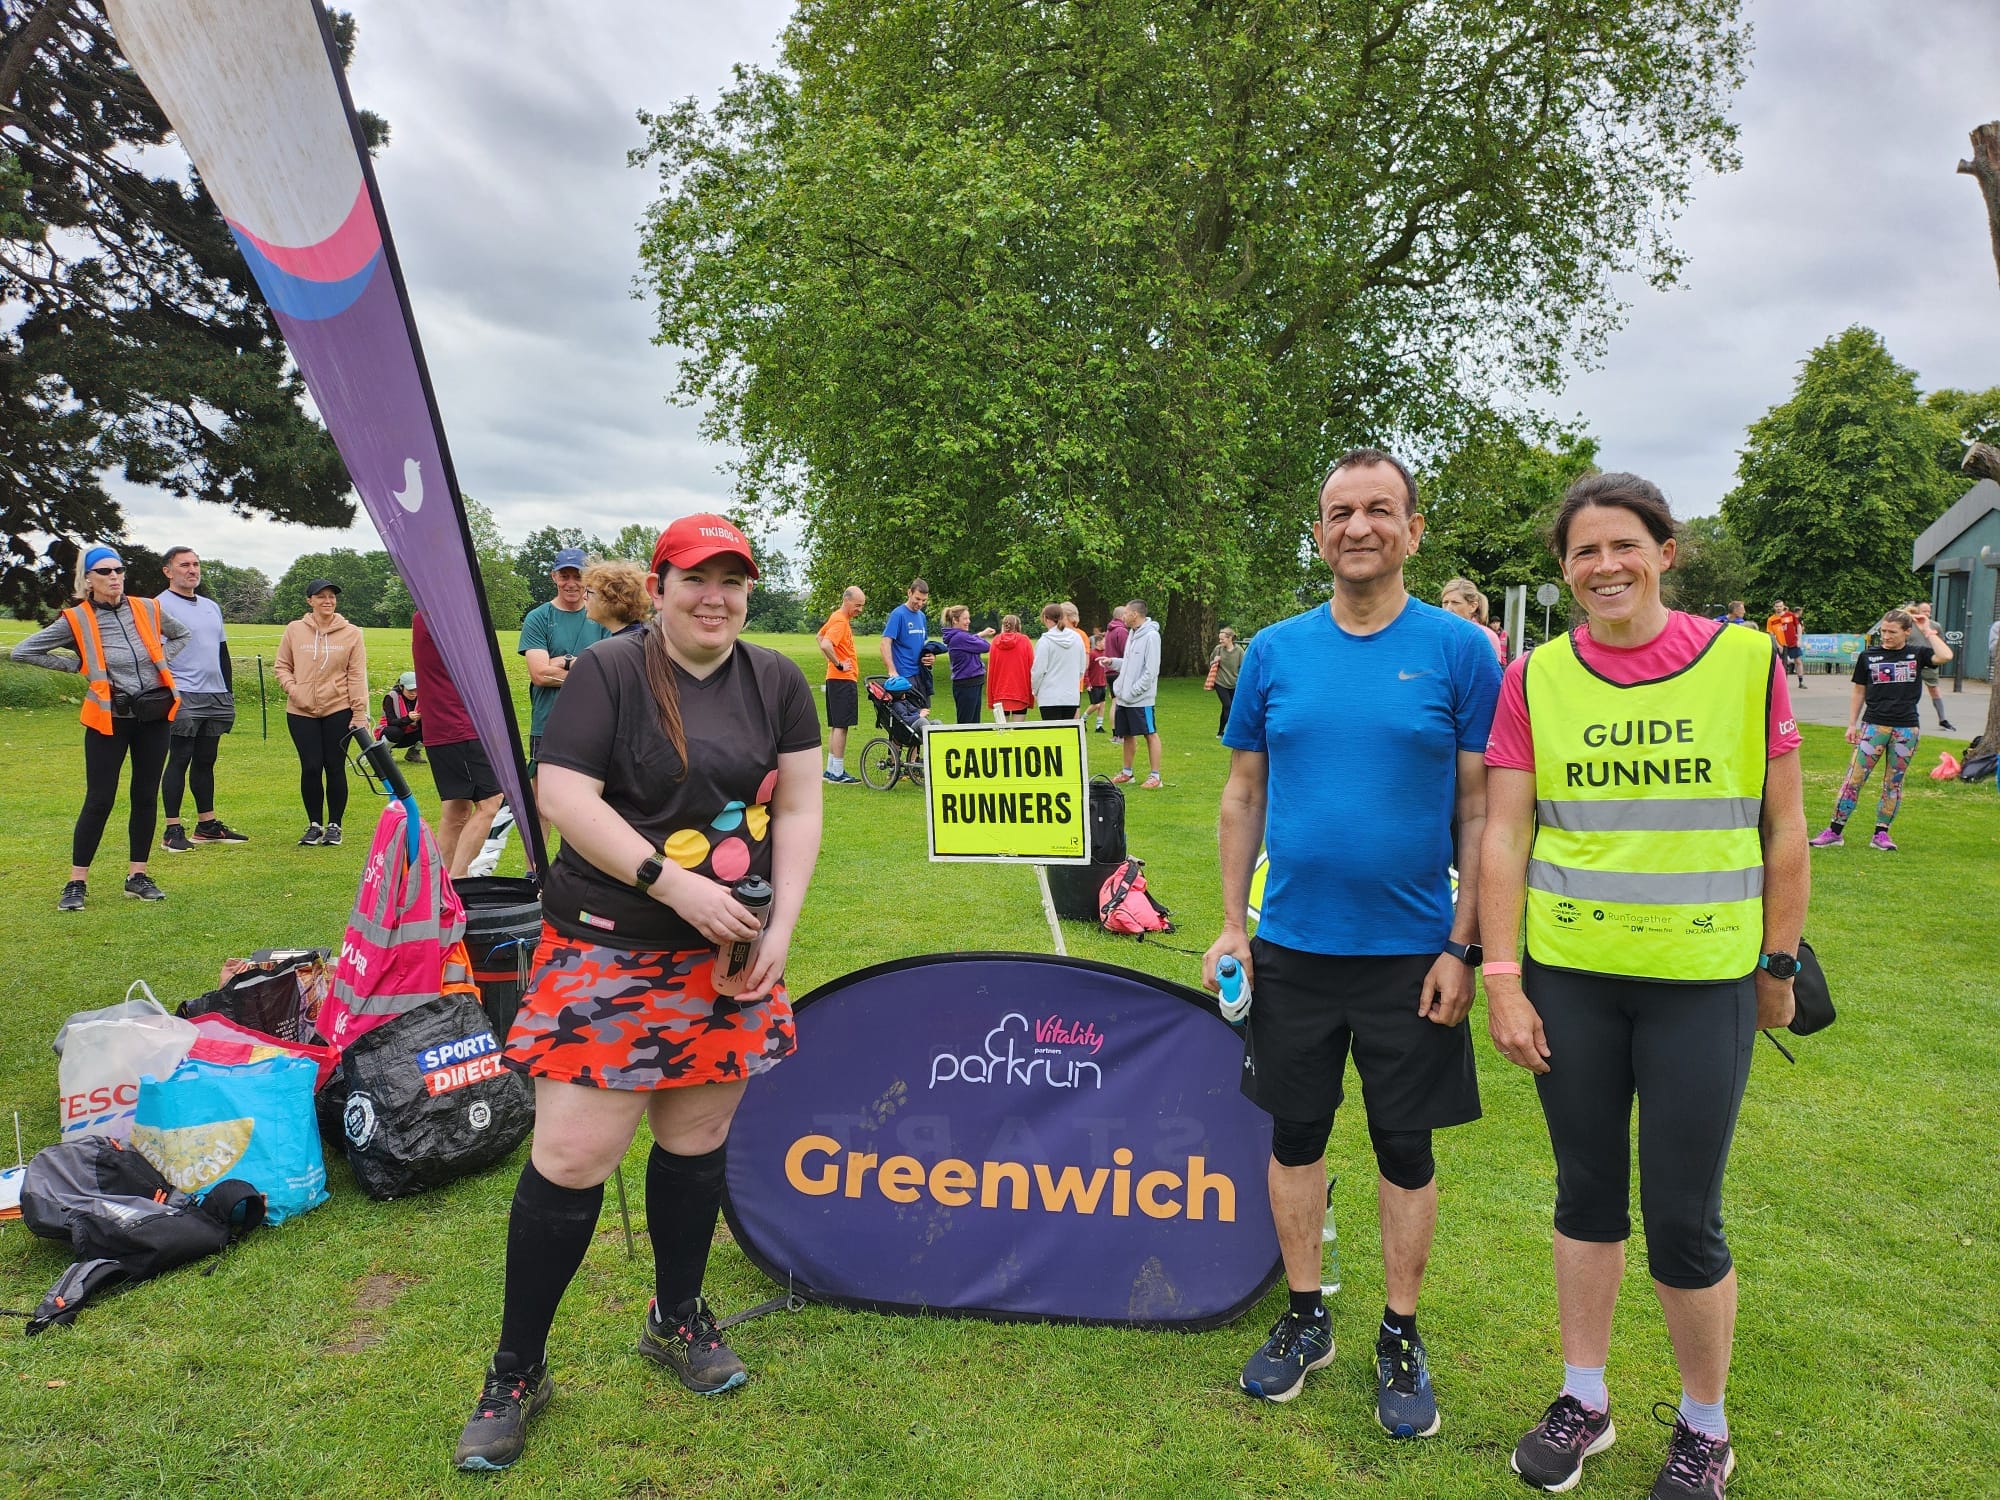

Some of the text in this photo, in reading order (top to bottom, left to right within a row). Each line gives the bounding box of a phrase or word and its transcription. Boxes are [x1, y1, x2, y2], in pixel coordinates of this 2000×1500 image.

[699, 527, 734, 542] TIKIBOO
[1583, 719, 1694, 747] GUIDE
[945, 746, 1063, 779] CAUTION
[1566, 758, 1712, 787] RUNNER
[942, 792, 1072, 824] RUNNERS
[1608, 911, 1673, 924] RunTogether
[424, 1033, 496, 1069] SPORTS
[1034, 1047, 1062, 1055] partners
[1035, 1014, 1105, 1055] Vitality
[433, 1054, 501, 1092] DIRECT
[928, 1037, 1102, 1089] parkrun
[61, 1084, 138, 1119] ESC
[784, 1134, 1236, 1222] Greenwich
